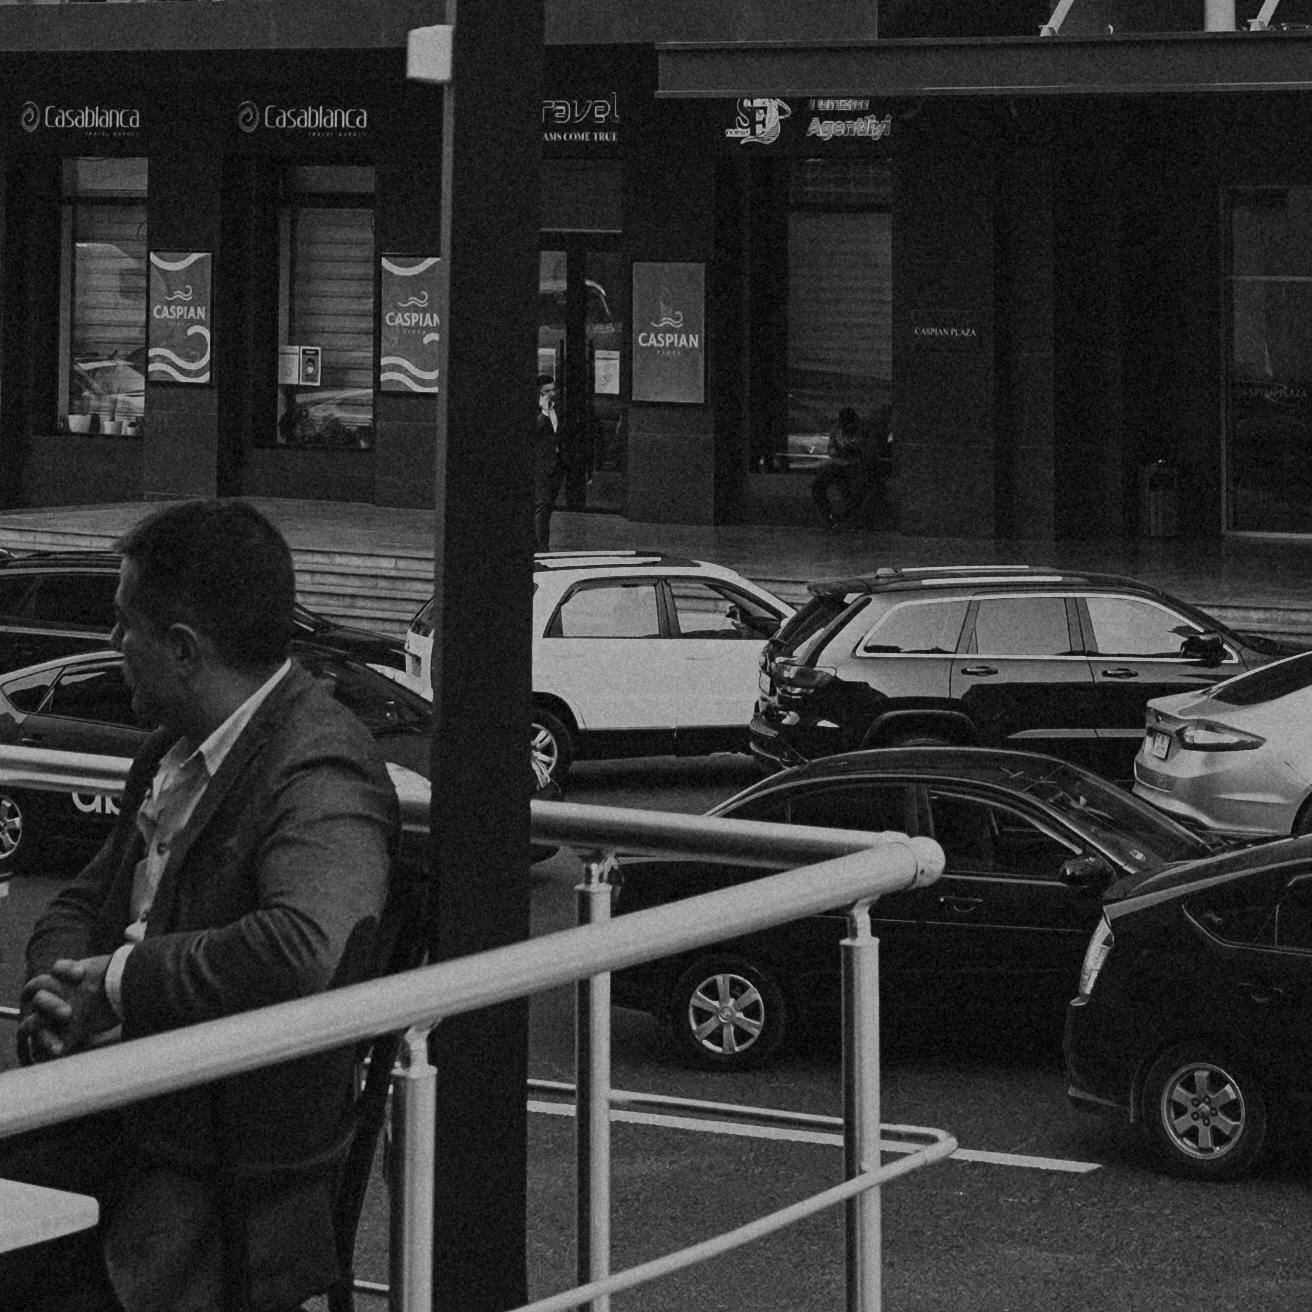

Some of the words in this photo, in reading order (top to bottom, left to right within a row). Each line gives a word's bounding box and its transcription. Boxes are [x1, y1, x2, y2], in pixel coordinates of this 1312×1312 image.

[45, 105, 140, 128] Casablanca
[265, 104, 368, 128] Casablanca
[563, 132, 591, 142] COME
[592, 132, 619, 142] TRUE
[152, 304, 206, 321] CASPIAN
[638, 332, 699, 349] CASPIAN
